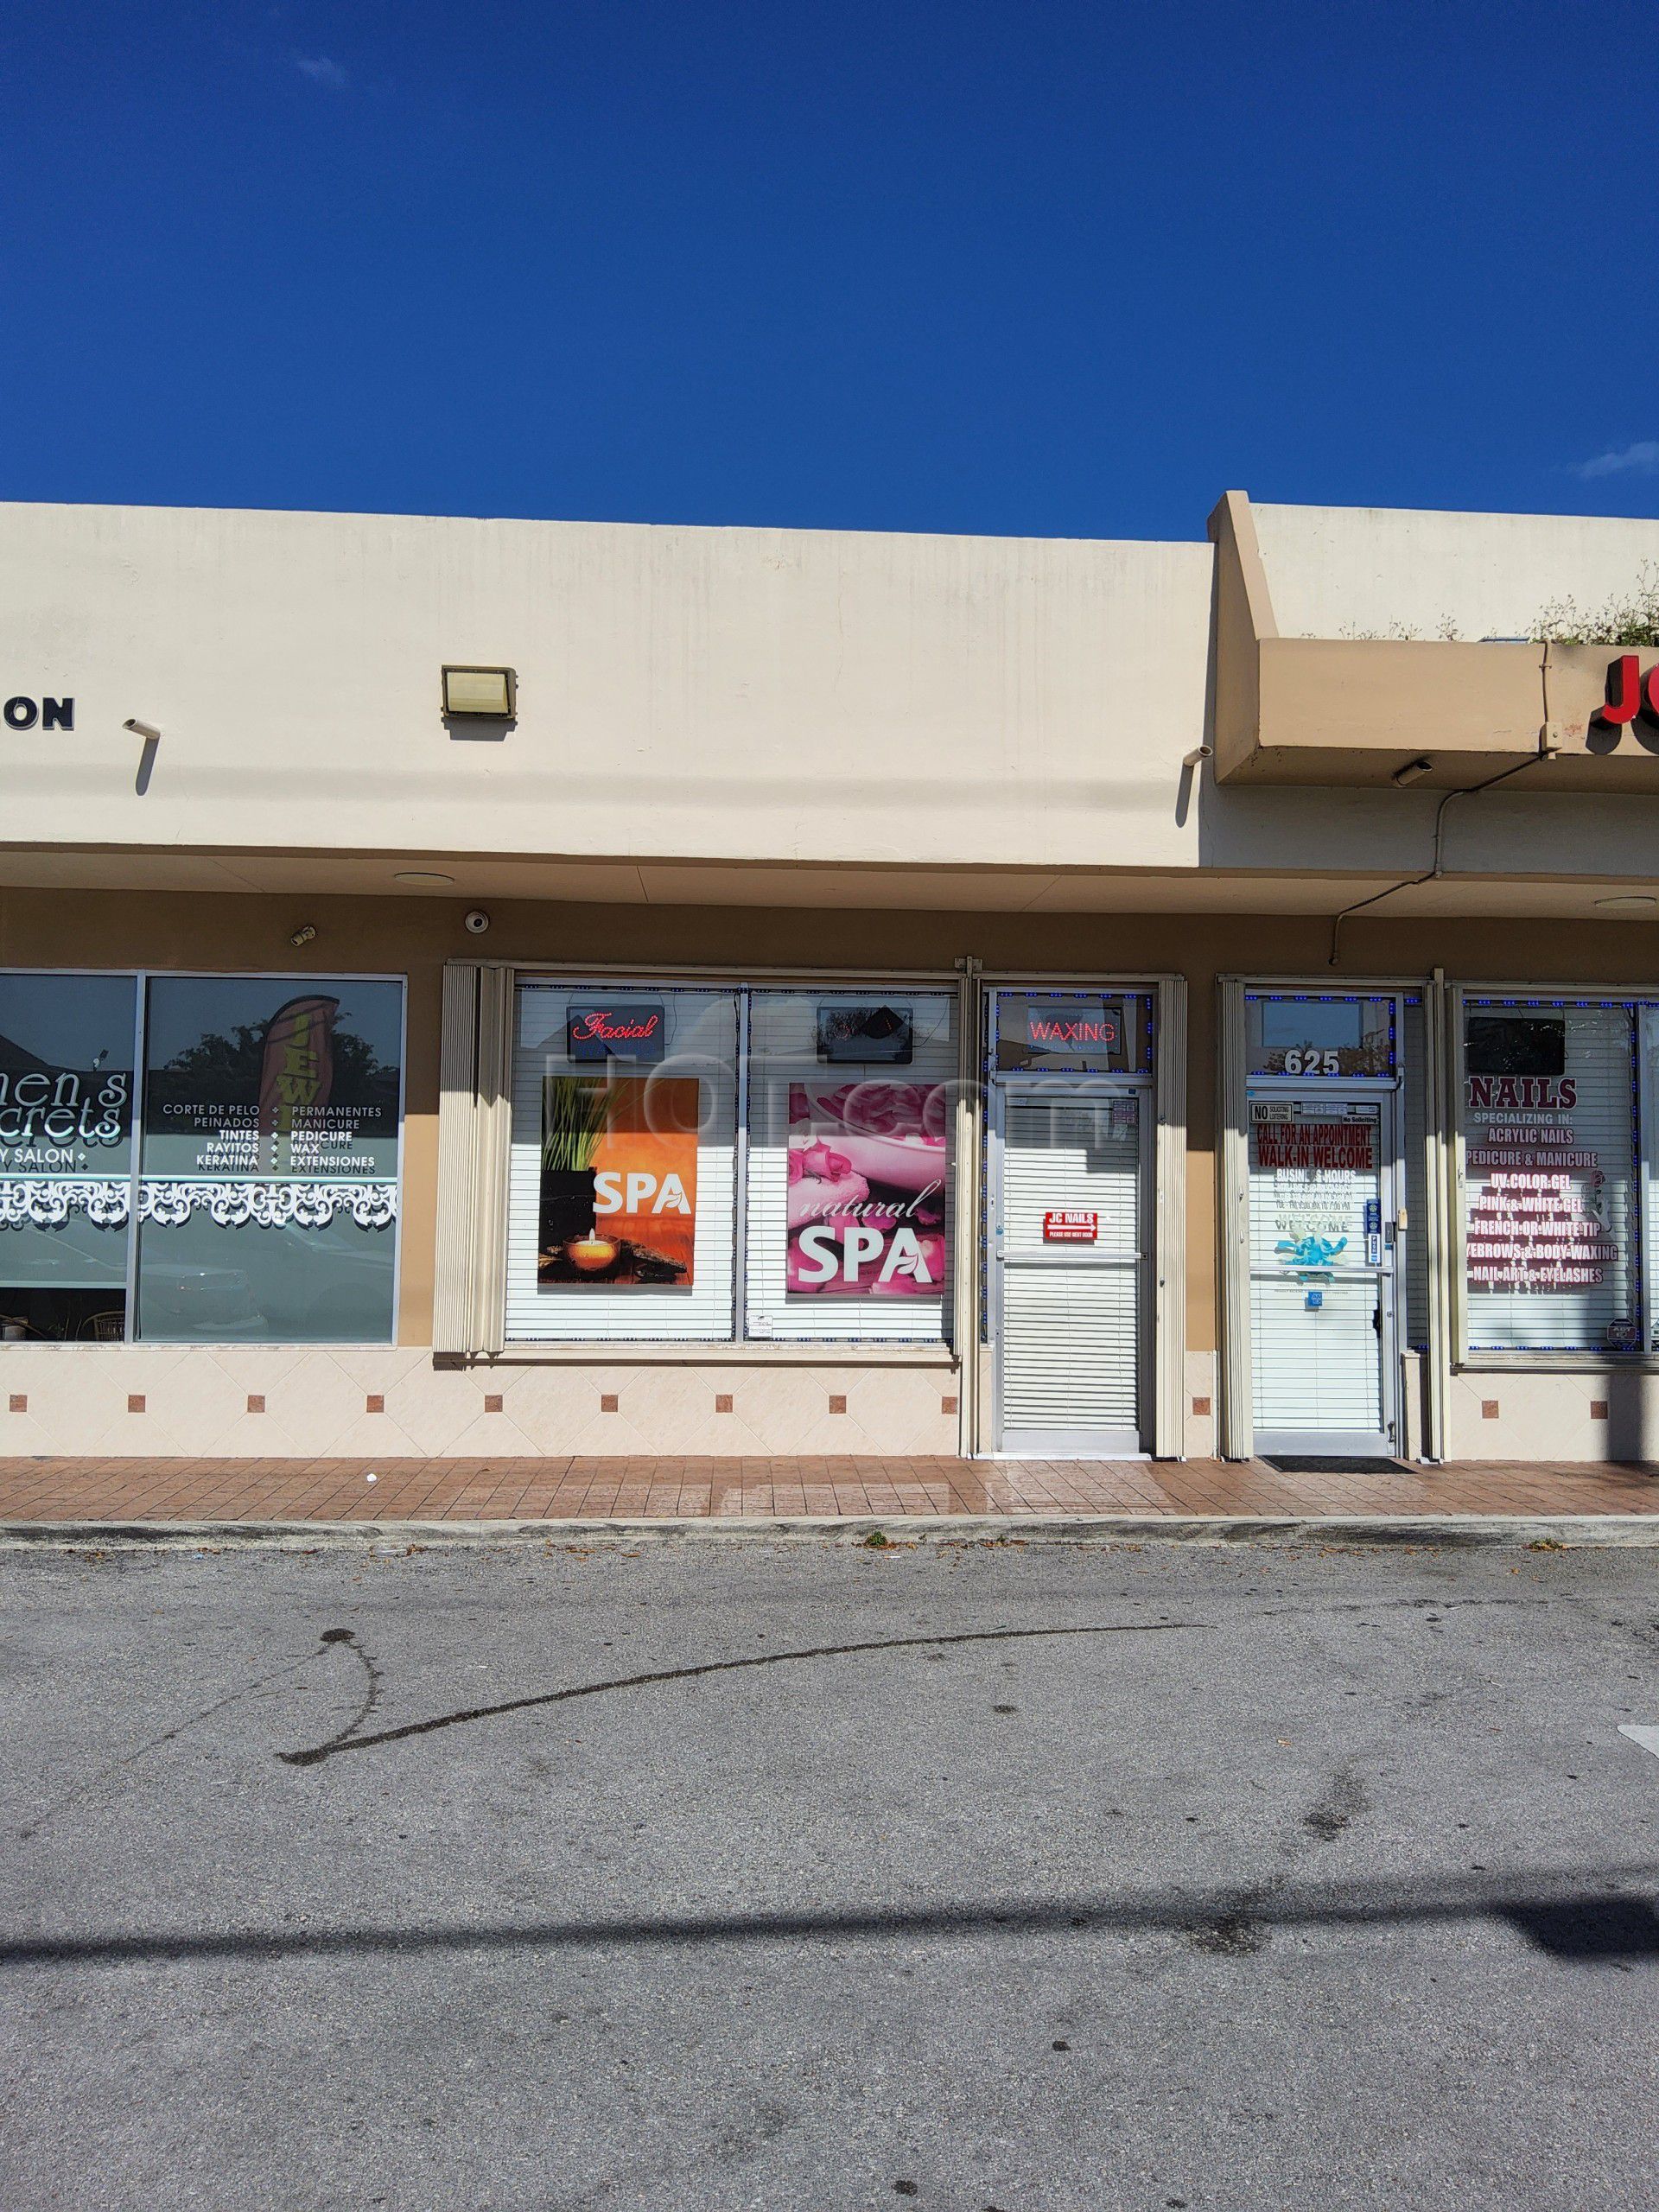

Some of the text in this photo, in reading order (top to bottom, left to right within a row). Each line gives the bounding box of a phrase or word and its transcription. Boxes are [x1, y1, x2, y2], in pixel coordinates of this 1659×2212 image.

[1602, 655, 1659, 726] J
[3, 696, 74, 731] ON
[573, 1012, 658, 1039] Facial
[1029, 1021, 1115, 1041] WAXING
[1285, 1049, 1339, 1074] 625
[1469, 1076, 1577, 1110] NAILS
[162, 1104, 260, 1116] CORTE DE PELO
[292, 1106, 382, 1117] PERMANENTES
[1255, 1106, 1268, 1120] NO
[1473, 1112, 1573, 1125] SPECIALIZING IN:
[194, 1117, 260, 1128] PEINADOS
[291, 1119, 360, 1129] MANICURE
[1351, 1116, 1377, 1124] Soliciting
[219, 1129, 259, 1141] TINTES
[290, 1131, 353, 1141] PEDICURE
[1257, 1124, 1372, 1147] CALL FOR AN APPOINTMENT
[1488, 1127, 1574, 1145] ACRYLIC NAILS
[14, 1148, 73, 1164] SALON
[207, 1142, 259, 1153] RAYITOS
[290, 1143, 320, 1154] WAX
[196, 1154, 258, 1166] KERATINA
[290, 1155, 375, 1166] EXTENSIONES
[1258, 1146, 1373, 1169] WALK-IN WELCOME
[1466, 1150, 1599, 1167] PEDICURE & MANICURE
[1324, 1169, 1357, 1183] HOURS
[1491, 1173, 1572, 1190] UV COLOR GEL
[592, 1172, 691, 1214] SPA
[800, 1179, 942, 1218] natural
[1478, 1195, 1583, 1213] PINK & WHITE GEL
[1048, 1212, 1094, 1224] JC NAILS
[1474, 1220, 1602, 1237] FRENCH OR WHITE TIP
[798, 1225, 932, 1283] SPA
[1523, 1247, 1534, 1259] &
[1535, 1243, 1567, 1260] BODY
[1570, 1244, 1618, 1261] WAXING
[1473, 1266, 1603, 1284] NAIL ART & EYELASHES
